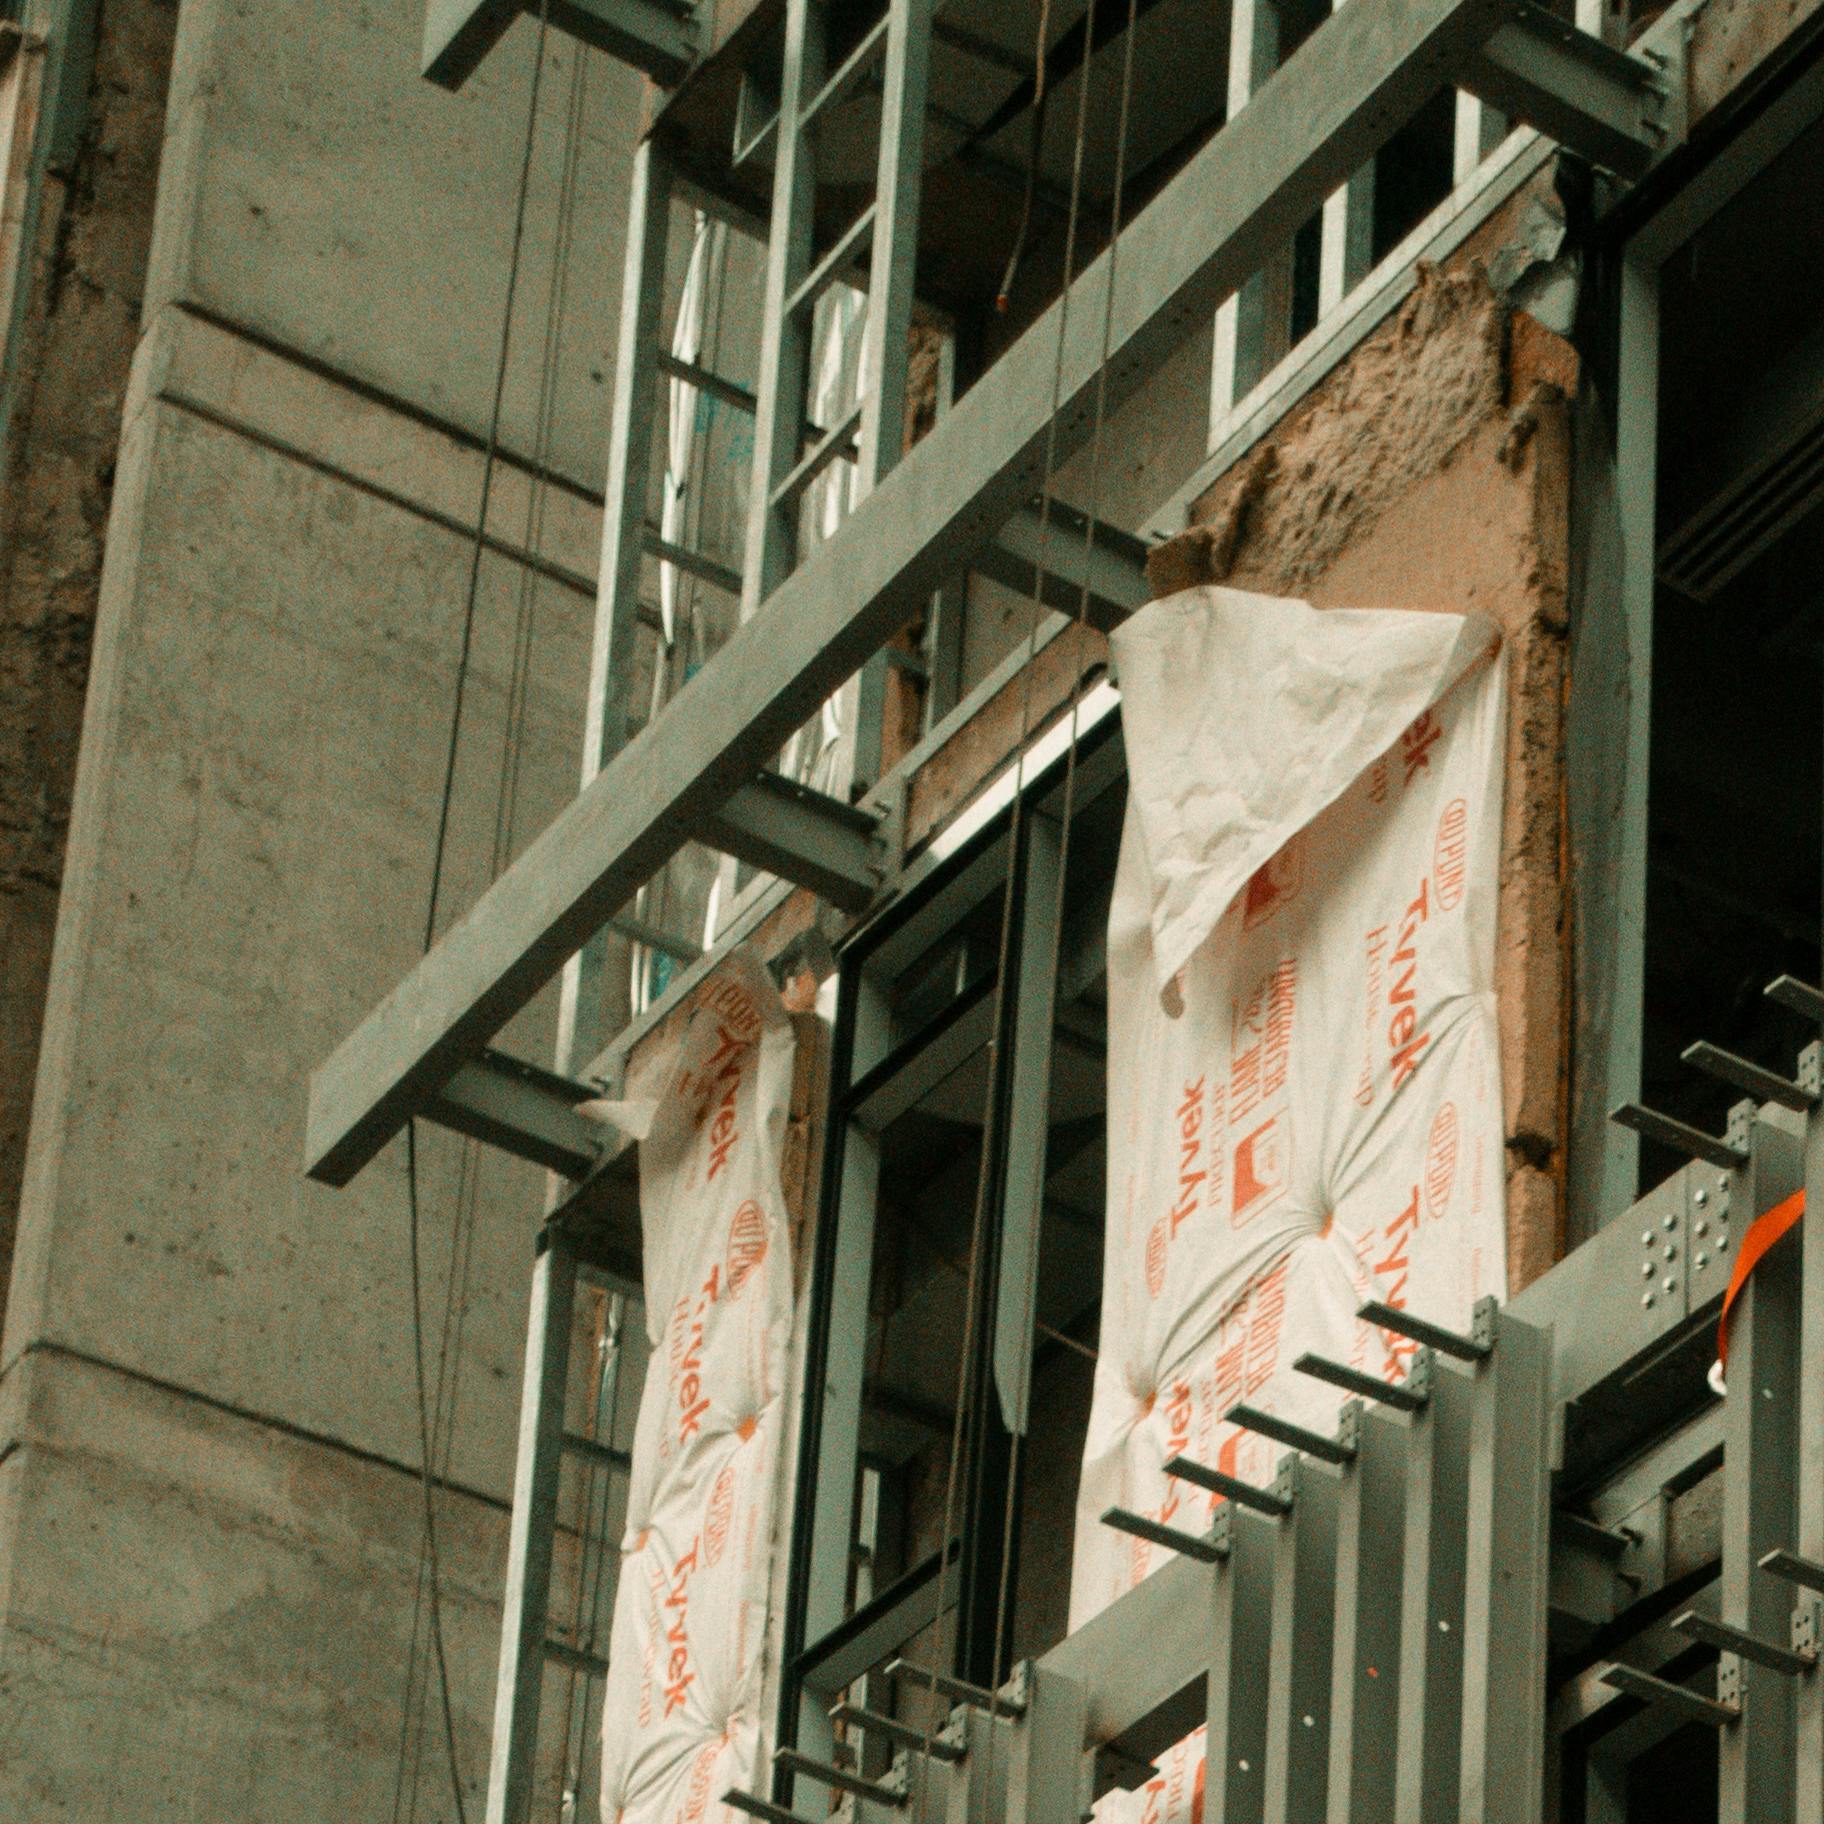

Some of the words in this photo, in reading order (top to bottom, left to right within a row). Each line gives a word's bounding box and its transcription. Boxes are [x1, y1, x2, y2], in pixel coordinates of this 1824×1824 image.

[1388, 877, 1431, 1092] Tyvek
[1170, 1075, 1207, 1241] Tyvek
[663, 1535, 700, 1719] Tyvek
